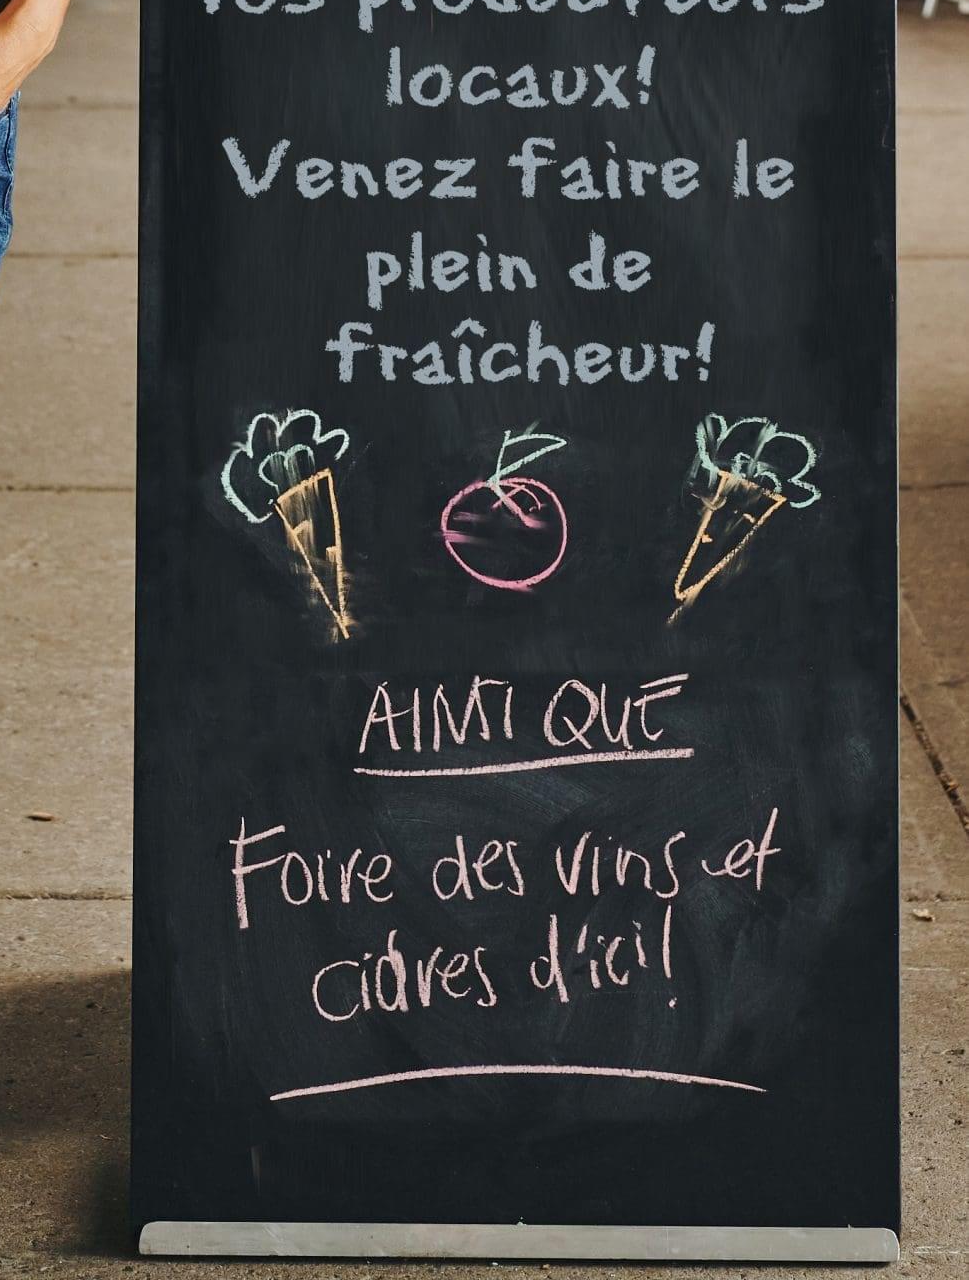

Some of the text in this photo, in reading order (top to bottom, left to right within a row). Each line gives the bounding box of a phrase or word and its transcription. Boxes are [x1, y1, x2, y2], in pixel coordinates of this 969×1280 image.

[386, 45, 655, 109] locaux!
[222, 137, 794, 200] Venez faire le
[367, 231, 651, 310] plein de
[325, 318, 715, 386] fraîcheur!
[544, 674, 688, 749] QUE
[229, 808, 781, 928] Foire des vins et
[312, 905, 675, 1021] cidres d'ici!
